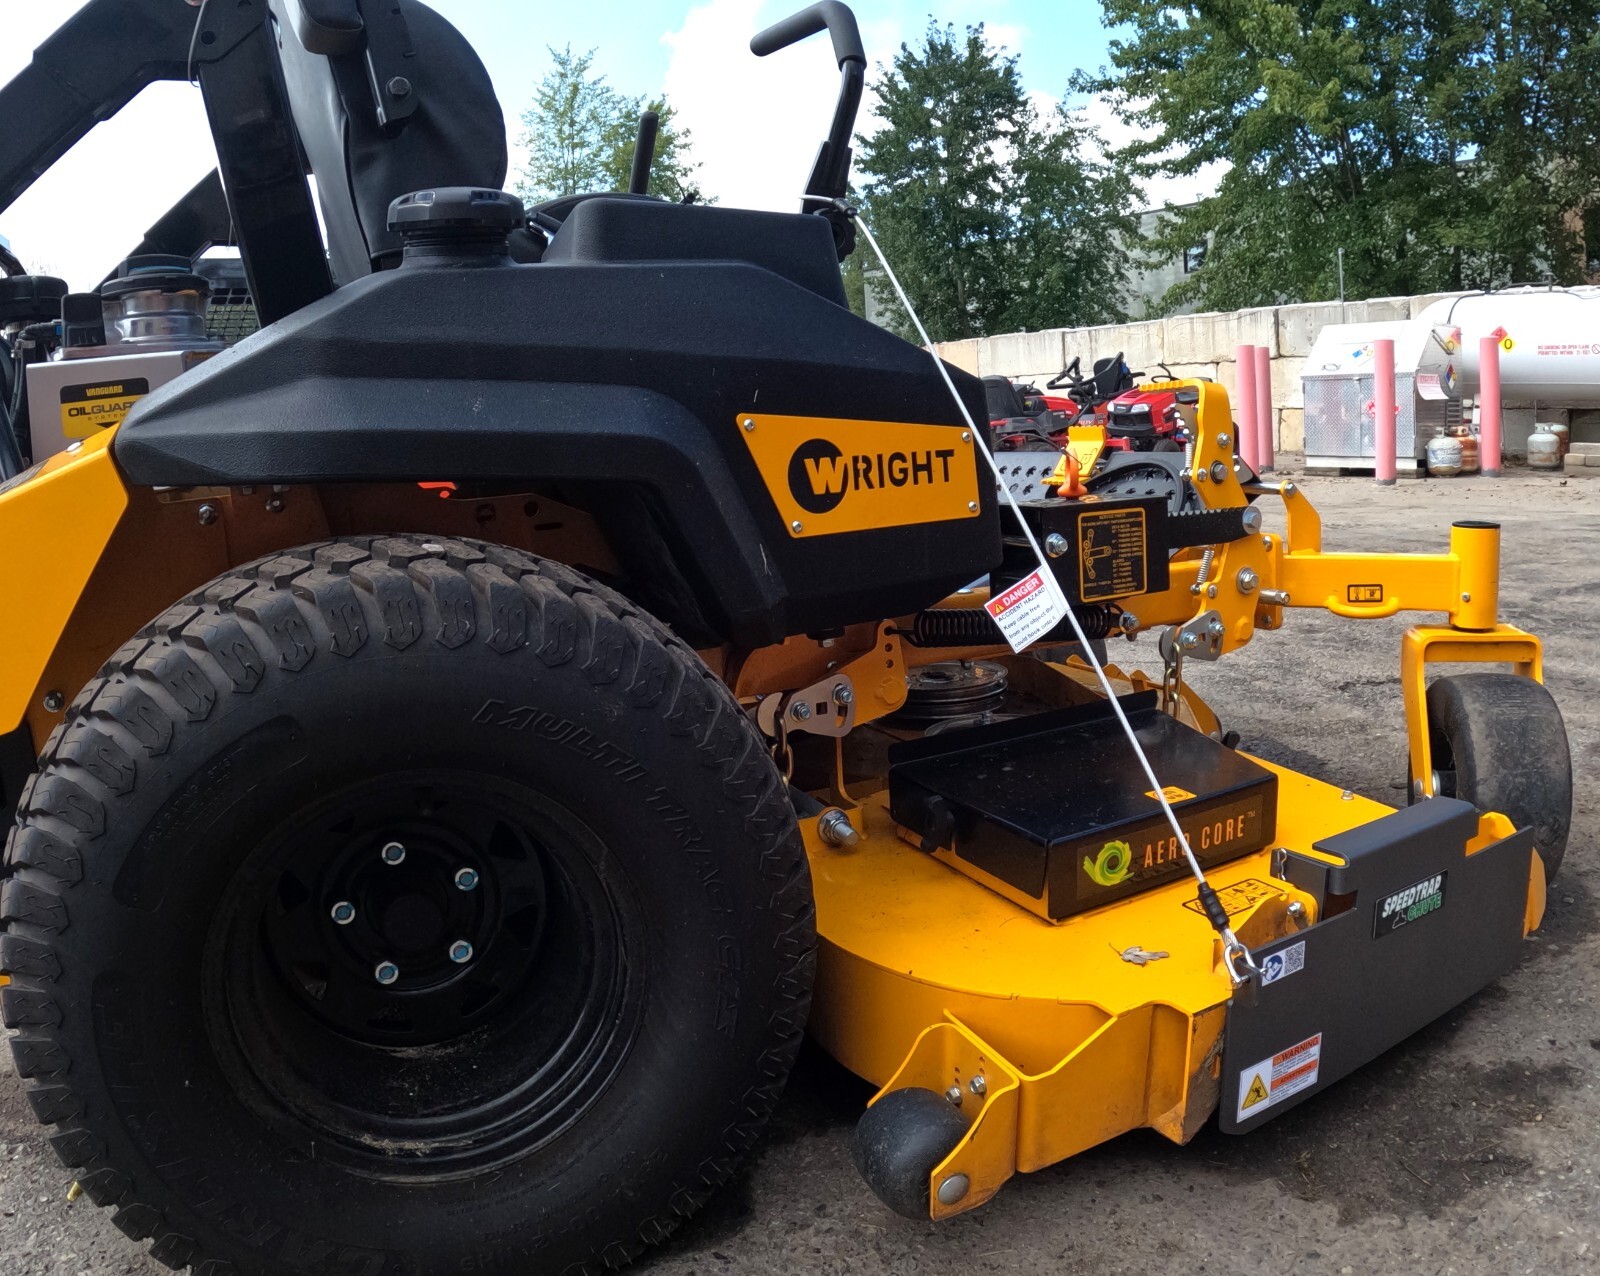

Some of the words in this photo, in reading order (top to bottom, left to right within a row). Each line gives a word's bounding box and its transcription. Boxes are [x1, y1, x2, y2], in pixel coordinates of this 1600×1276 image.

[1504, 338, 1513, 350] 0
[85, 385, 123, 397] VANGUARD
[68, 401, 134, 418] OILGUAR
[803, 448, 956, 496] WRIGHT
[998, 602, 1023, 622] ACCIDENT
[1023, 586, 1046, 605] HAZARD
[1002, 577, 1040, 606] DANGER
[1003, 620, 1017, 630] Keep
[1017, 611, 1030, 622] cable
[1029, 604, 1041, 613] free
[1008, 629, 1021, 639] from
[1021, 623, 1030, 632] any
[1030, 612, 1046, 625] object
[1014, 636, 1028, 648] could
[1027, 627, 1041, 639] hook
[1041, 619, 1053, 630] onto
[1201, 815, 1245, 850] CORE
[1382, 874, 1442, 918] SPEEDTRAP
[1407, 891, 1442, 922] CHUTE
[1281, 1036, 1320, 1062] WARNING
